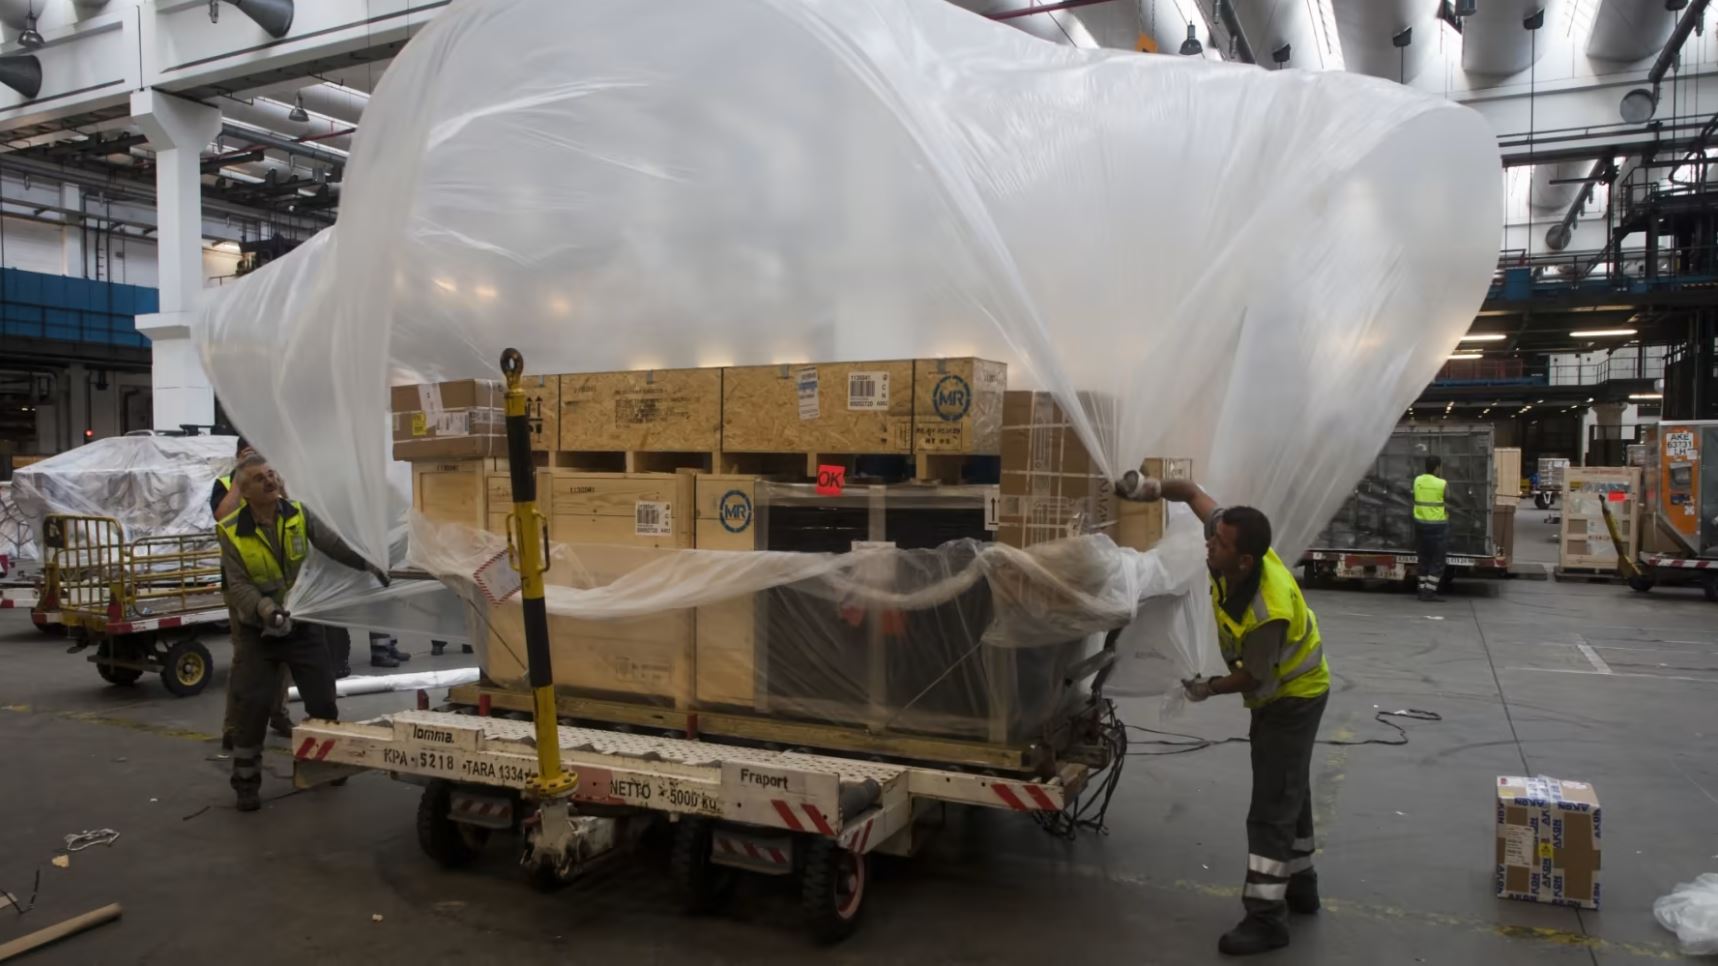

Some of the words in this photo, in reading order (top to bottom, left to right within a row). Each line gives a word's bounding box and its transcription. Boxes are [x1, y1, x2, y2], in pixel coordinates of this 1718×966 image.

[939, 390, 964, 406] MR
[817, 471, 841, 488] OK
[724, 504, 747, 519] MR
[419, 752, 454, 770] 5218
[741, 768, 788, 789] Fraport
[610, 780, 652, 799] NETTO
